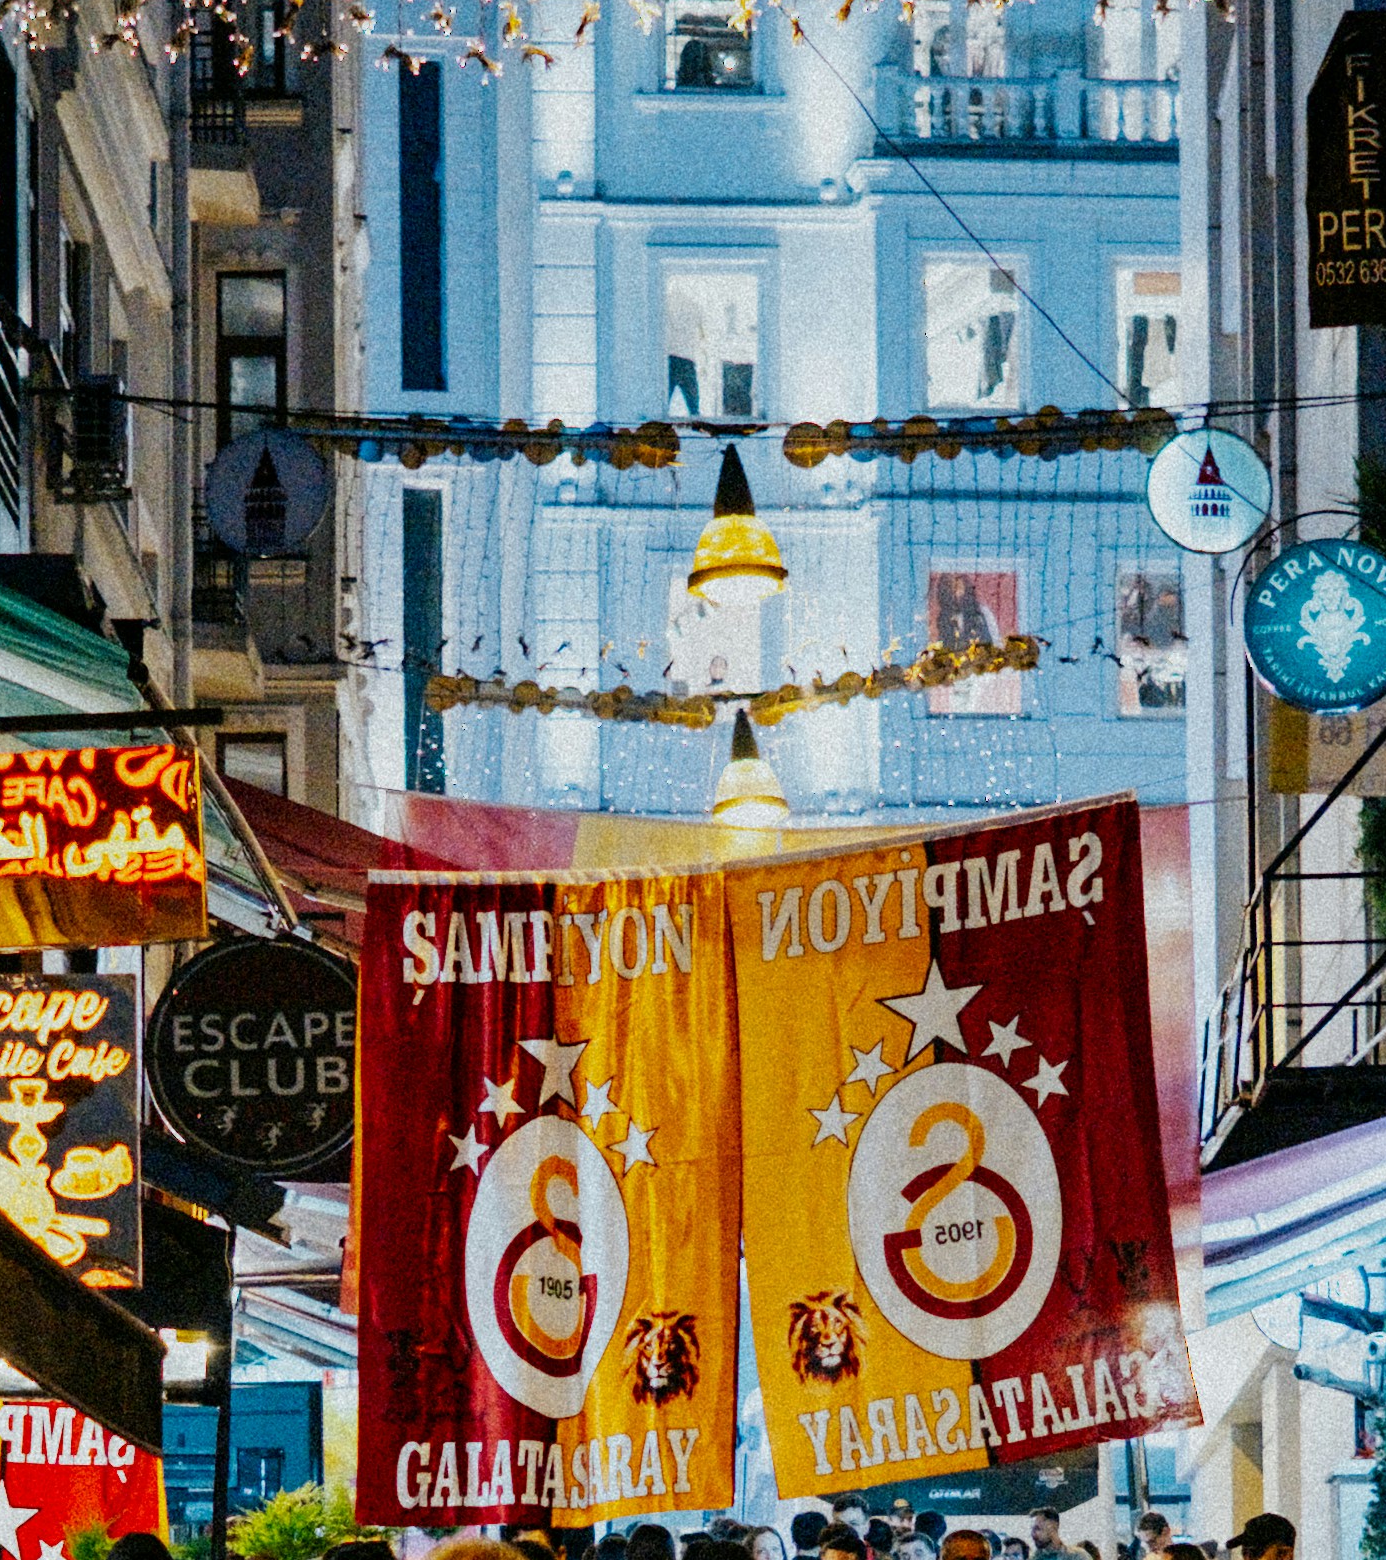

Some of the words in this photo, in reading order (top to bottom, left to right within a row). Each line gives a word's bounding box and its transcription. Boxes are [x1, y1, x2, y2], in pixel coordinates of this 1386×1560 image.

[1315, 260, 1355, 286] 0532
[1257, 550, 1323, 609] PERA
[173, 1011, 356, 1053] ESCAPE
[44, 1041, 131, 1083] Cafe
[183, 1058, 350, 1098] CLUB
[538, 1275, 574, 1302] 1905
[396, 1427, 701, 1511] GALATASARAY
